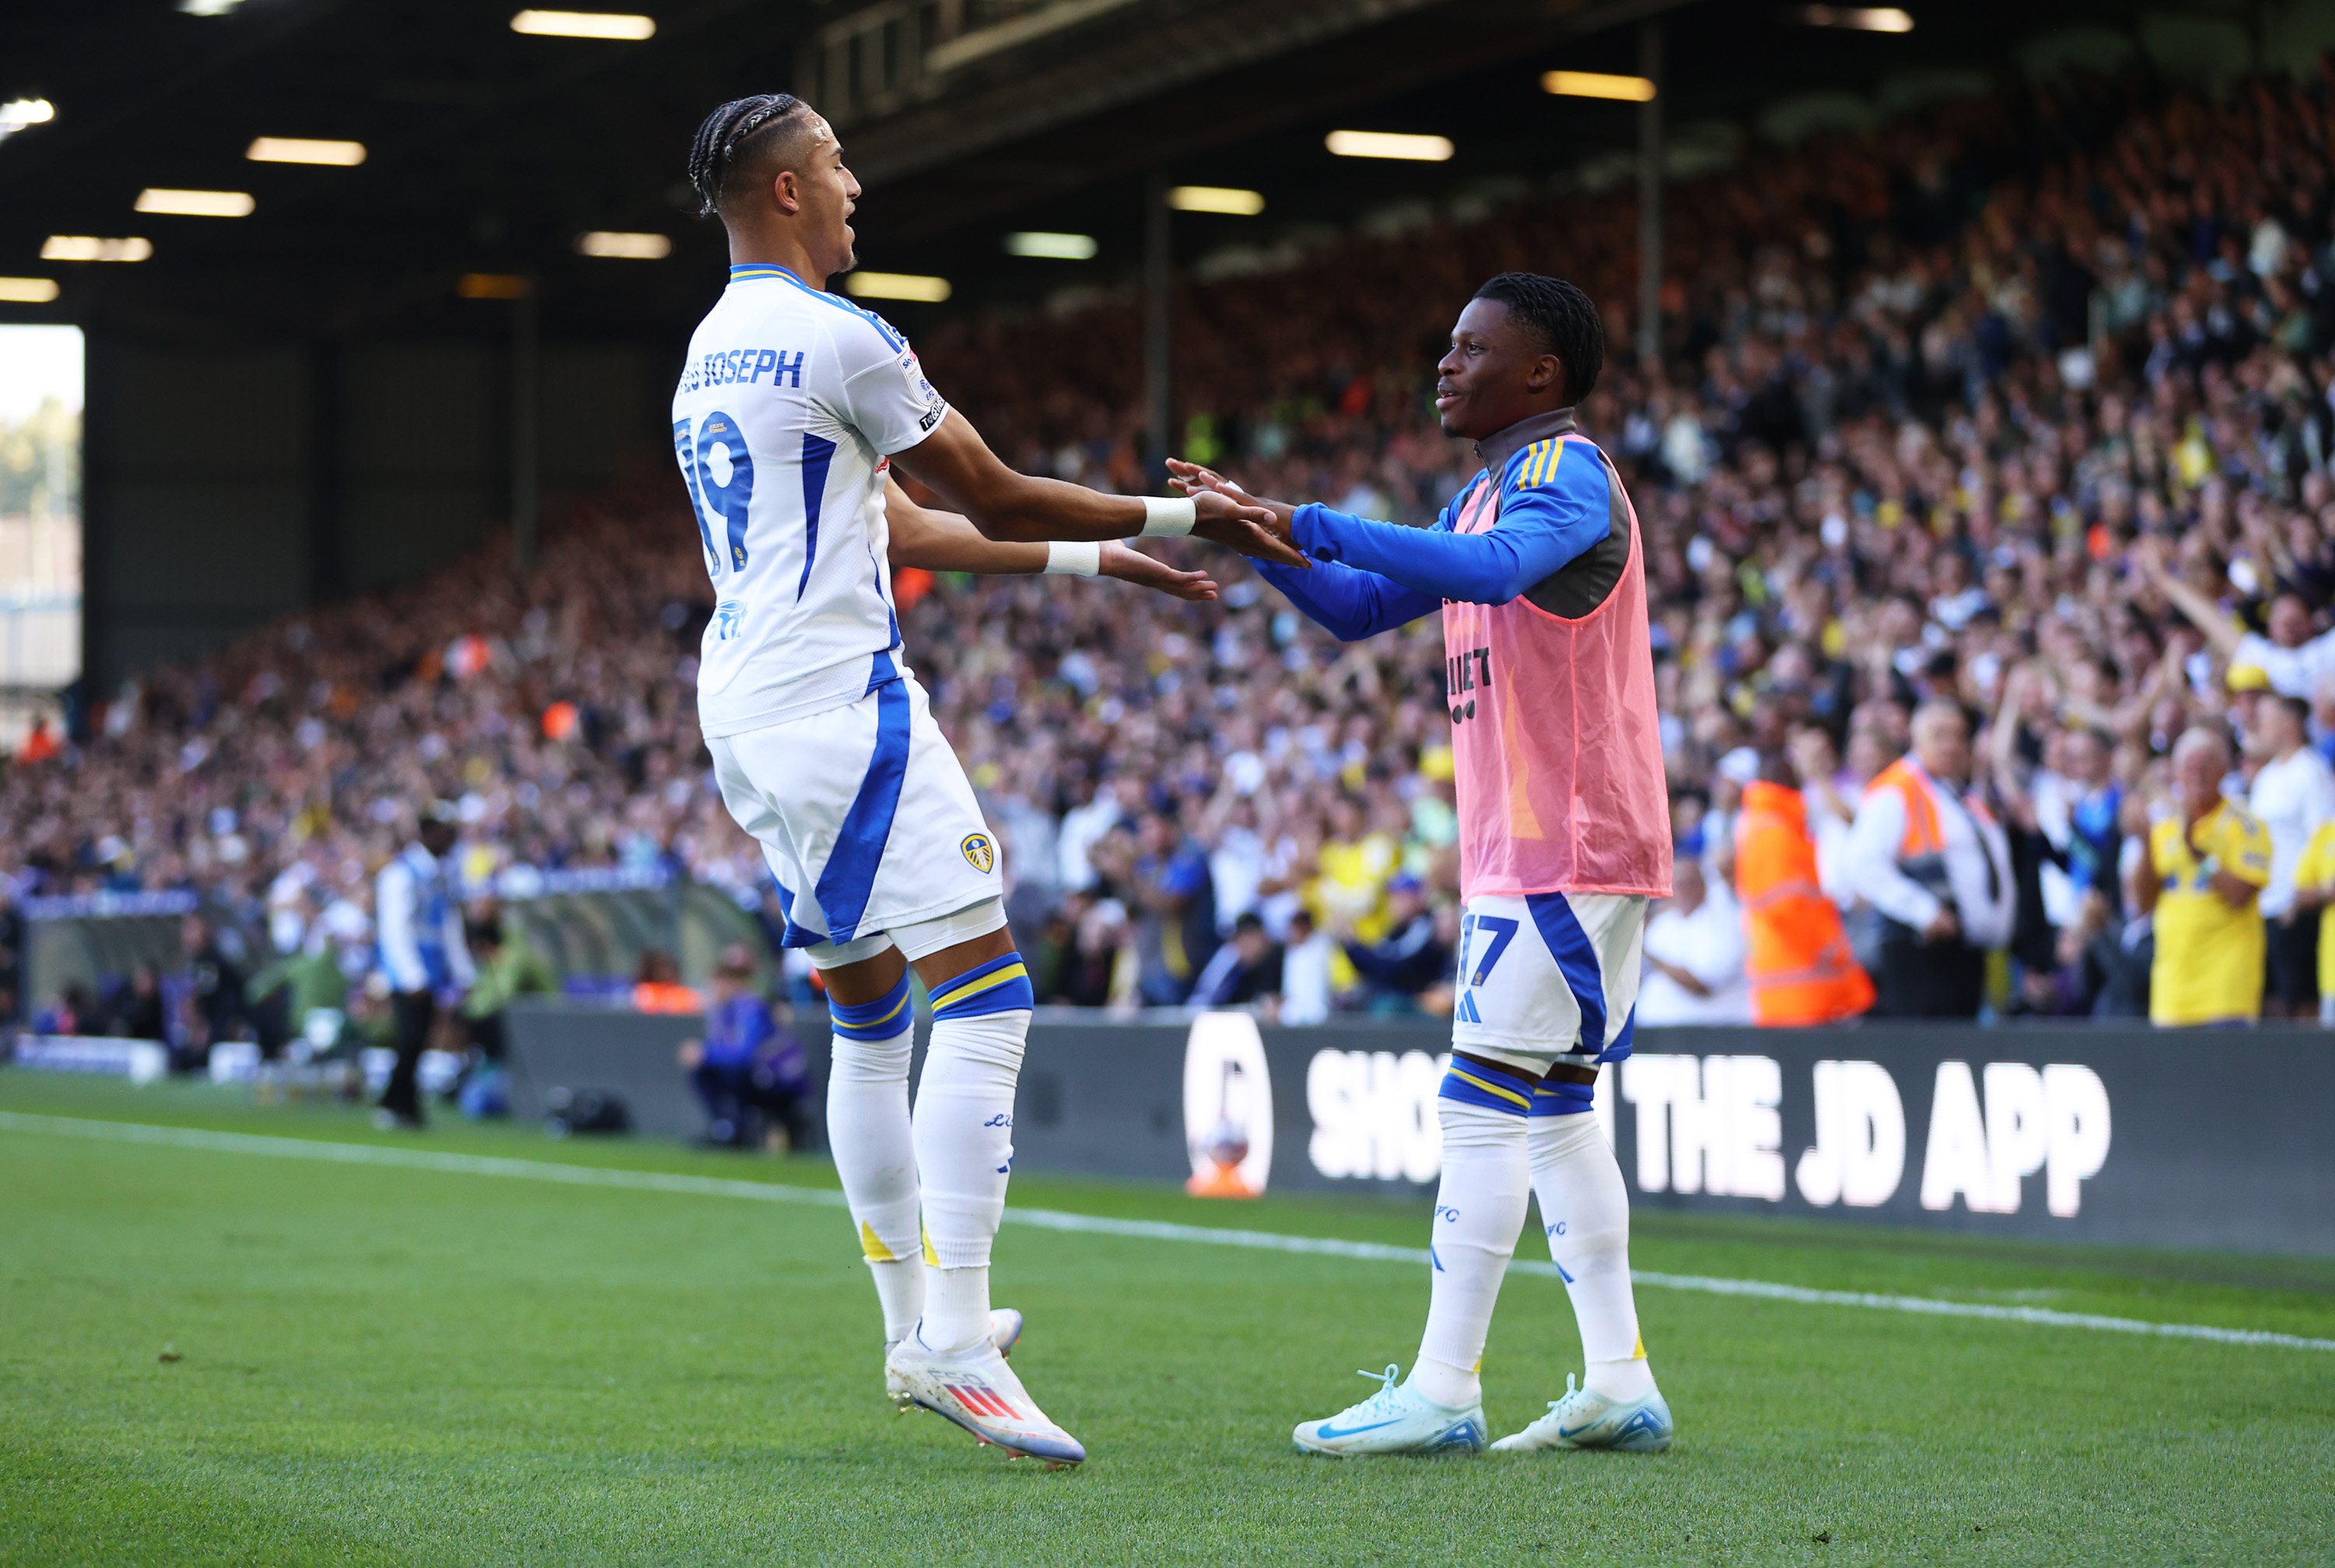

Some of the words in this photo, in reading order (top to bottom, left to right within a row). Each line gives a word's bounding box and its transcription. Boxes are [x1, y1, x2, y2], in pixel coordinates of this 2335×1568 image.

[704, 349, 804, 388] JOSEPH
[674, 412, 754, 577] 19
[1459, 914, 1520, 987] 17
[984, 1114, 1013, 1127] LU
[1306, 1047, 1452, 1186] SHO
[1621, 1053, 1786, 1203] THE
[1795, 1059, 1907, 1208] JD
[1919, 1061, 2112, 1219] APP
